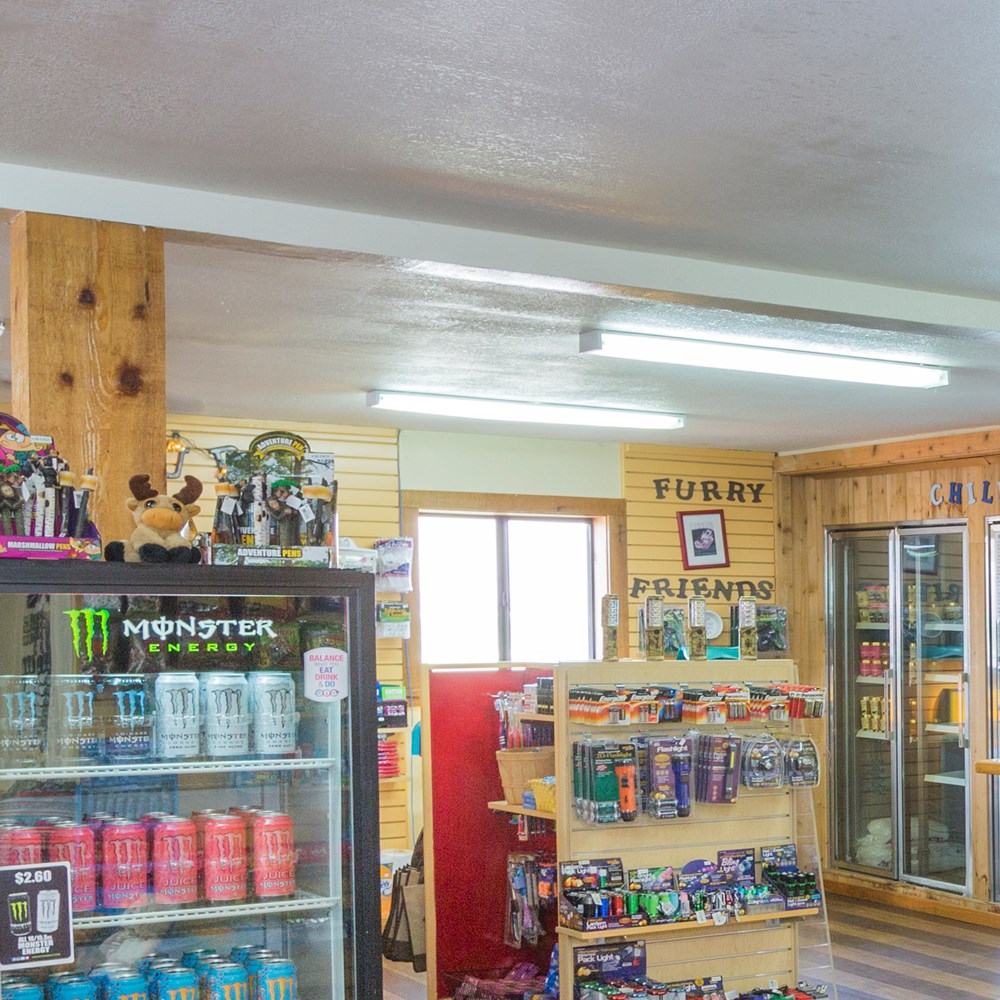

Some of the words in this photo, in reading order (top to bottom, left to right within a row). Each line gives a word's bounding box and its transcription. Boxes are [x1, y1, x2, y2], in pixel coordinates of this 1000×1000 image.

[257, 437, 293, 450] ADVENTURE
[653, 478, 765, 503] FURRY
[7, 541, 56, 550] MARSHMALLOW
[237, 548, 281, 557] ADVENTURE
[282, 549, 302, 558] PENS
[630, 577, 774, 601] FRIENDS
[122, 616, 278, 640] MONSTER
[148, 642, 256, 653] ENERGY
[161, 732, 198, 741] MONSTE
[656, 744, 688, 753] Flashlight
[15, 870, 52, 885] $2.60
[111, 881, 145, 891] JUICE
[18, 939, 54, 950] MONSTER
[22, 946, 50, 956] ENERGY
[577, 955, 596, 963] Pack
[597, 953, 614, 962] Light
